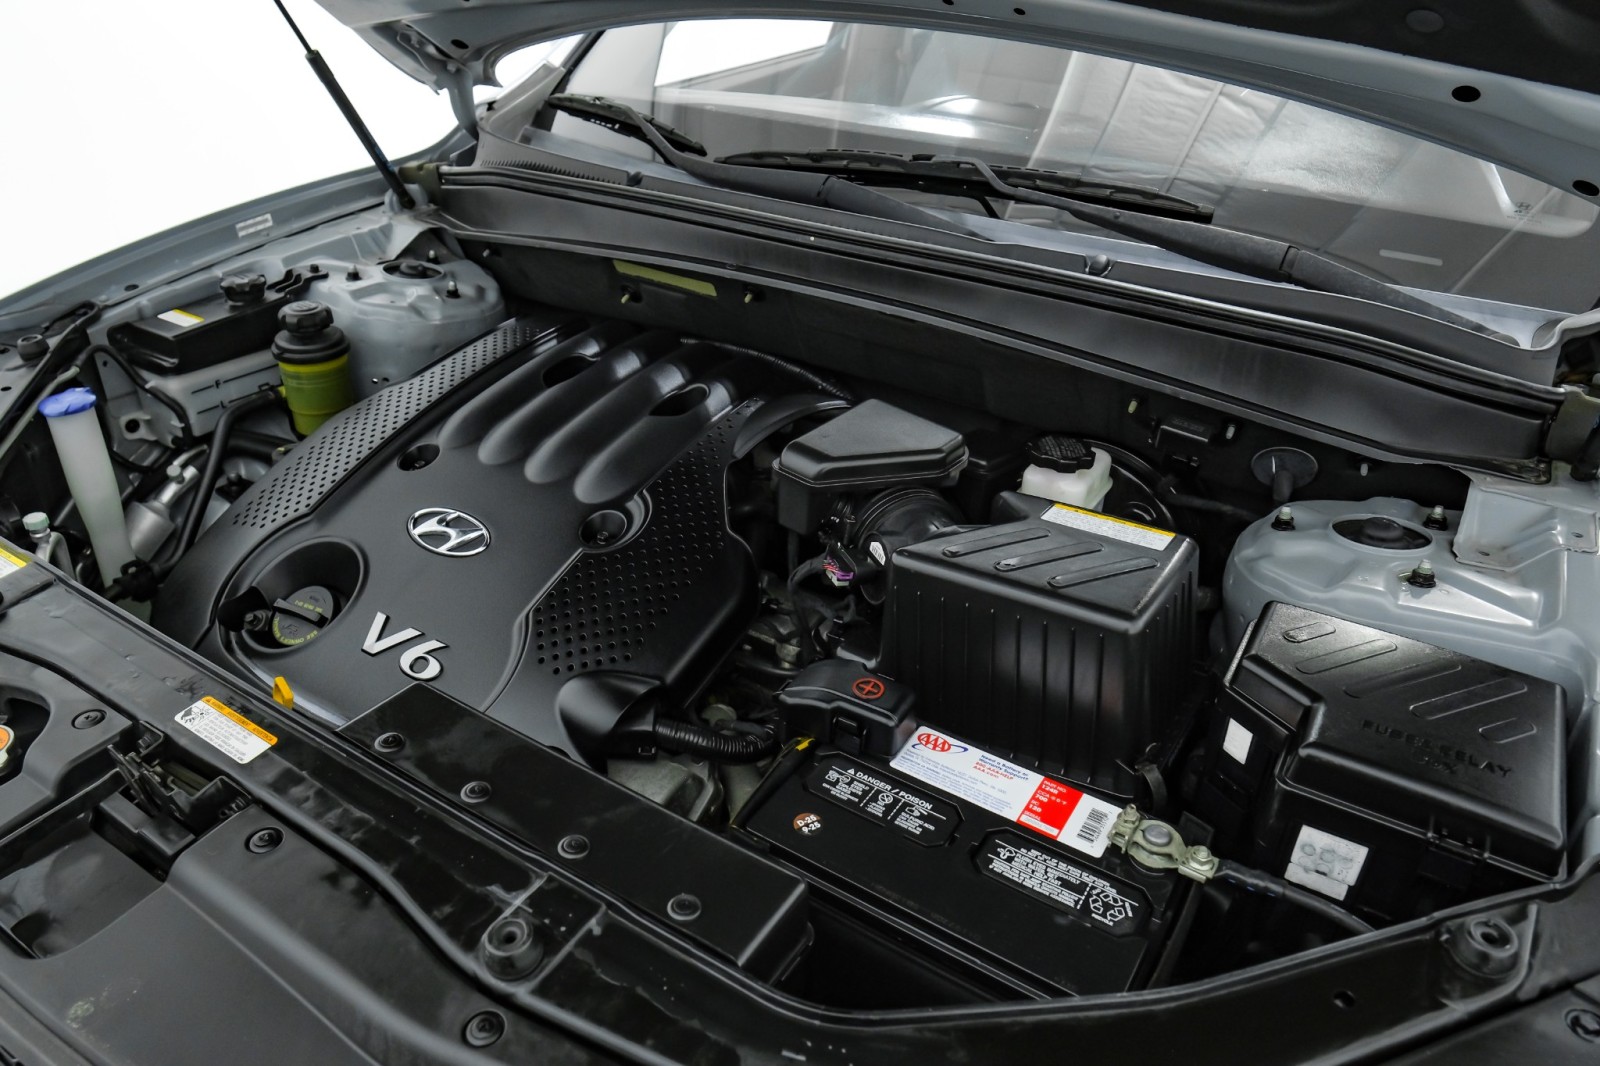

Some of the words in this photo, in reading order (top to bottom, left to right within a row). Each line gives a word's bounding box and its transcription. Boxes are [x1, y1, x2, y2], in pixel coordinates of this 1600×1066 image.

[361, 611, 450, 682] V6
[918, 733, 951, 752] AAA
[856, 771, 892, 791] DANGER
[898, 791, 933, 810] POISON
[1035, 793, 1048, 803] 700
